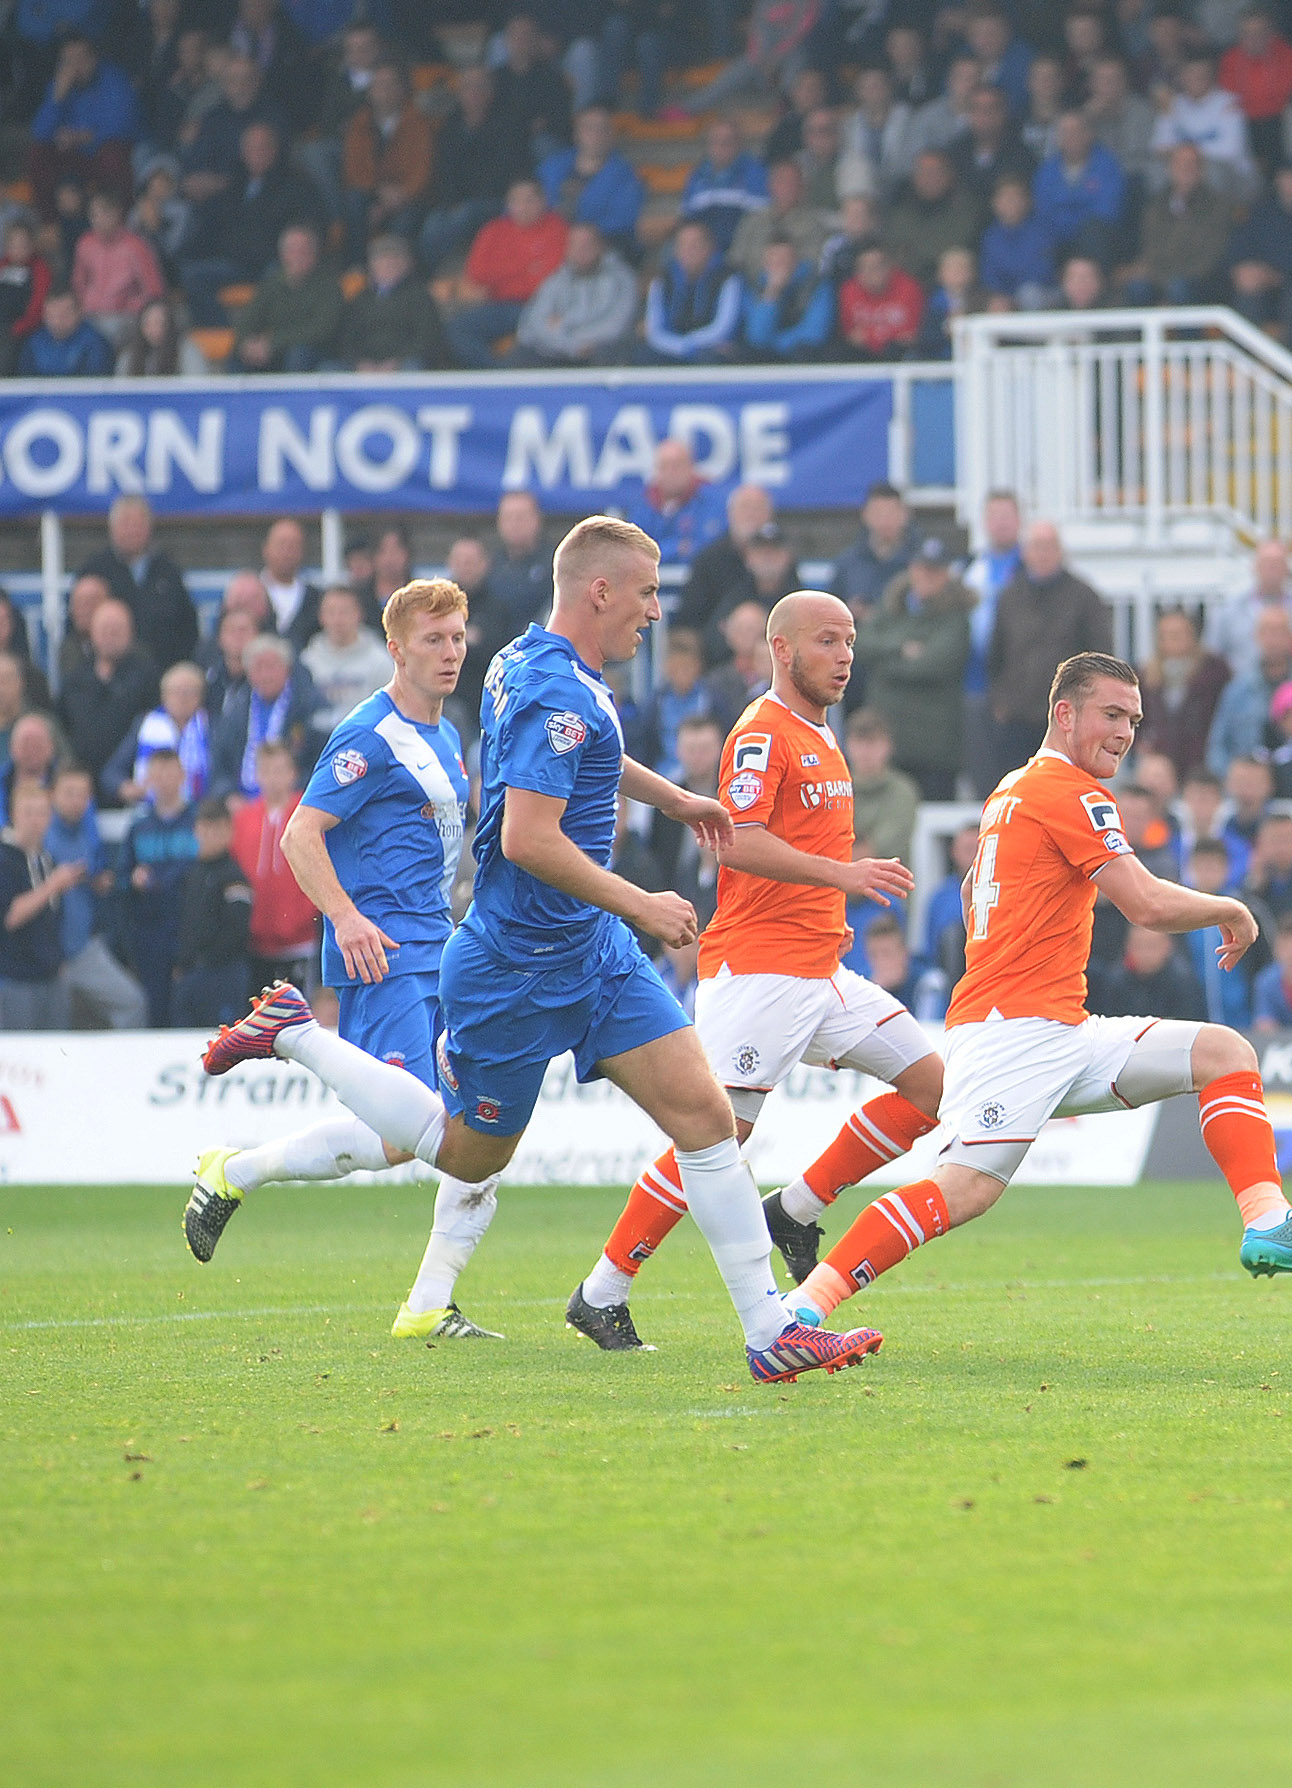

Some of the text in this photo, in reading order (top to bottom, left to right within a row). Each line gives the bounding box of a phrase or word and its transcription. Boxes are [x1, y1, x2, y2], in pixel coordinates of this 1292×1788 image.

[2, 400, 794, 496] ORN NOT MADE
